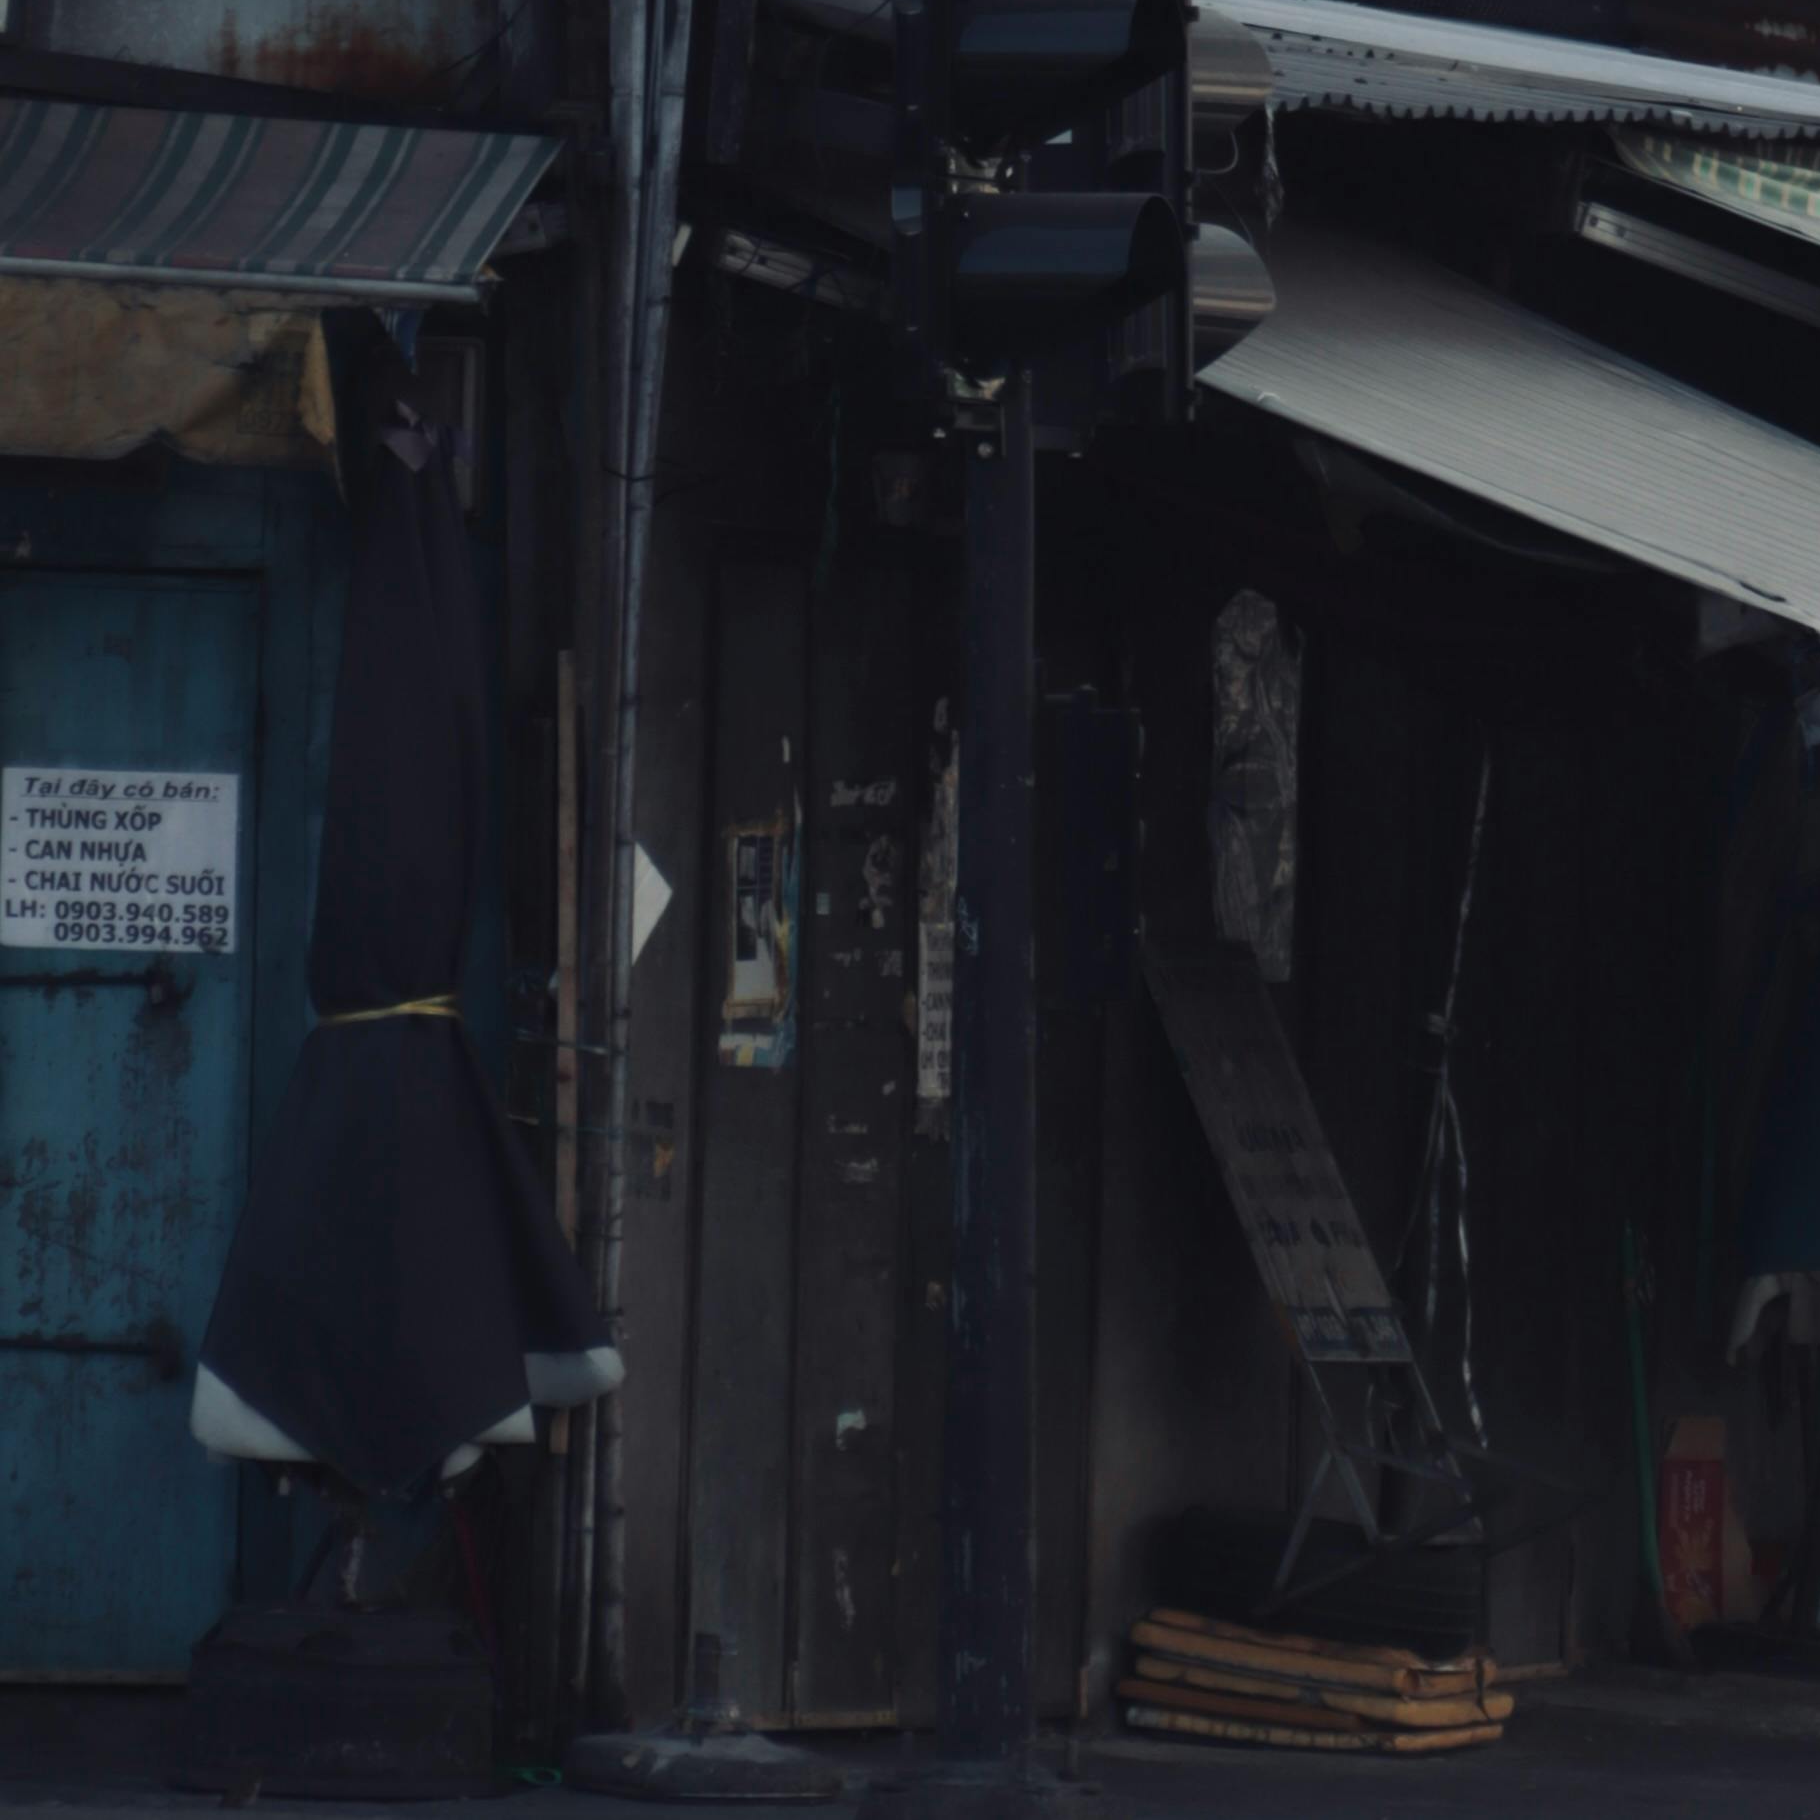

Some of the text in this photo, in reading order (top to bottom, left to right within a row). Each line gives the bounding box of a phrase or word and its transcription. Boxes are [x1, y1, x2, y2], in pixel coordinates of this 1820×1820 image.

[25, 776, 221, 800] Tại đây có bán:
[26, 802, 107, 831] THÙNG
[25, 839, 72, 860] CAN
[80, 839, 147, 867] NHỰA
[24, 870, 82, 892] CHAI
[90, 867, 159, 894] NƯỚC
[165, 868, 225, 896] SUỐI
[5, 899, 229, 924] LH: 0903.940.589
[54, 922, 228, 947] 0903.994.962
